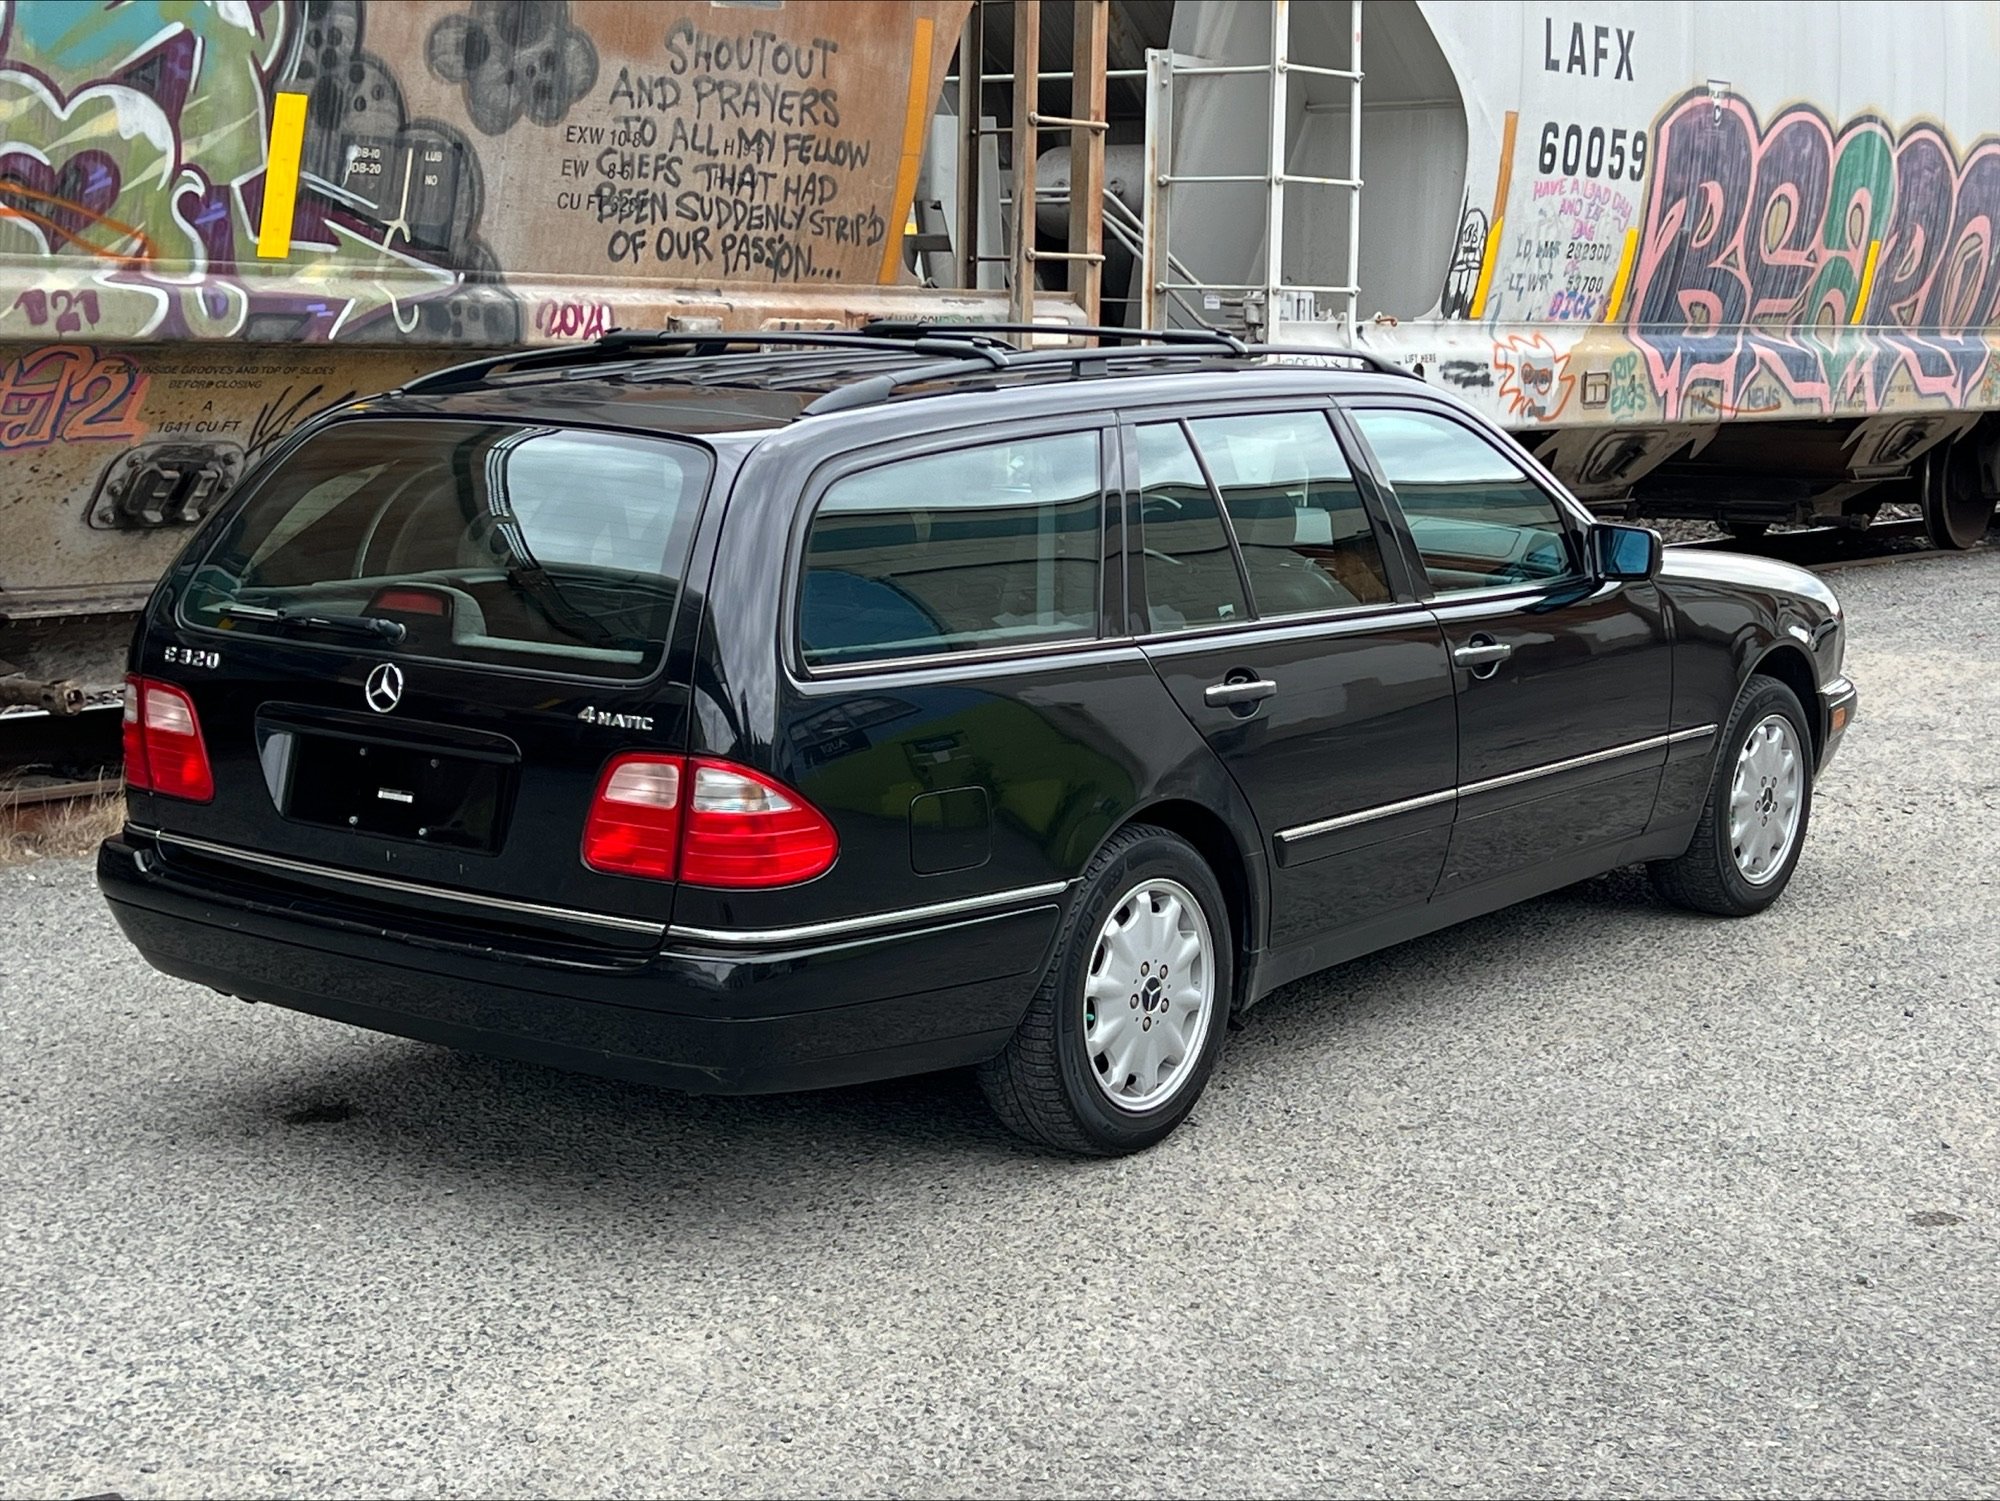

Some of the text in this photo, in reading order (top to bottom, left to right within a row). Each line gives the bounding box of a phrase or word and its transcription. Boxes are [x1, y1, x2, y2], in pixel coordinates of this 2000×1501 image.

[665, 17, 838, 78] SHOUTOUT
[1545, 17, 1635, 81] LAFX
[609, 67, 840, 128] AND PRAYERS
[566, 125, 604, 145] EXW
[613, 115, 870, 171] TO ALL MY FELLOW
[425, 151, 443, 162] LUB
[1538, 121, 1647, 182] 60059
[351, 162, 381, 174] DB-20
[561, 159, 589, 178] EW
[596, 147, 683, 188] CHEFS
[693, 162, 777, 202] THAT
[784, 172, 838, 206] HAD
[1533, 178, 1567, 201] HAVE
[558, 192, 581, 211] CU
[595, 182, 885, 247] BEEN SUDDENLY STRIP'D
[607, 229, 646, 264] OF
[655, 226, 713, 265] OUR
[103, 366, 138, 375] CEAN
[181, 366, 235, 375] GROOVES
[236, 366, 259, 375] AND
[261, 366, 282, 375] TOP
[284, 366, 299, 375] OF
[215, 380, 263, 389] CLOSING
[202, 400, 213, 412] A
[158, 420, 242, 433] 1641 CU FT
